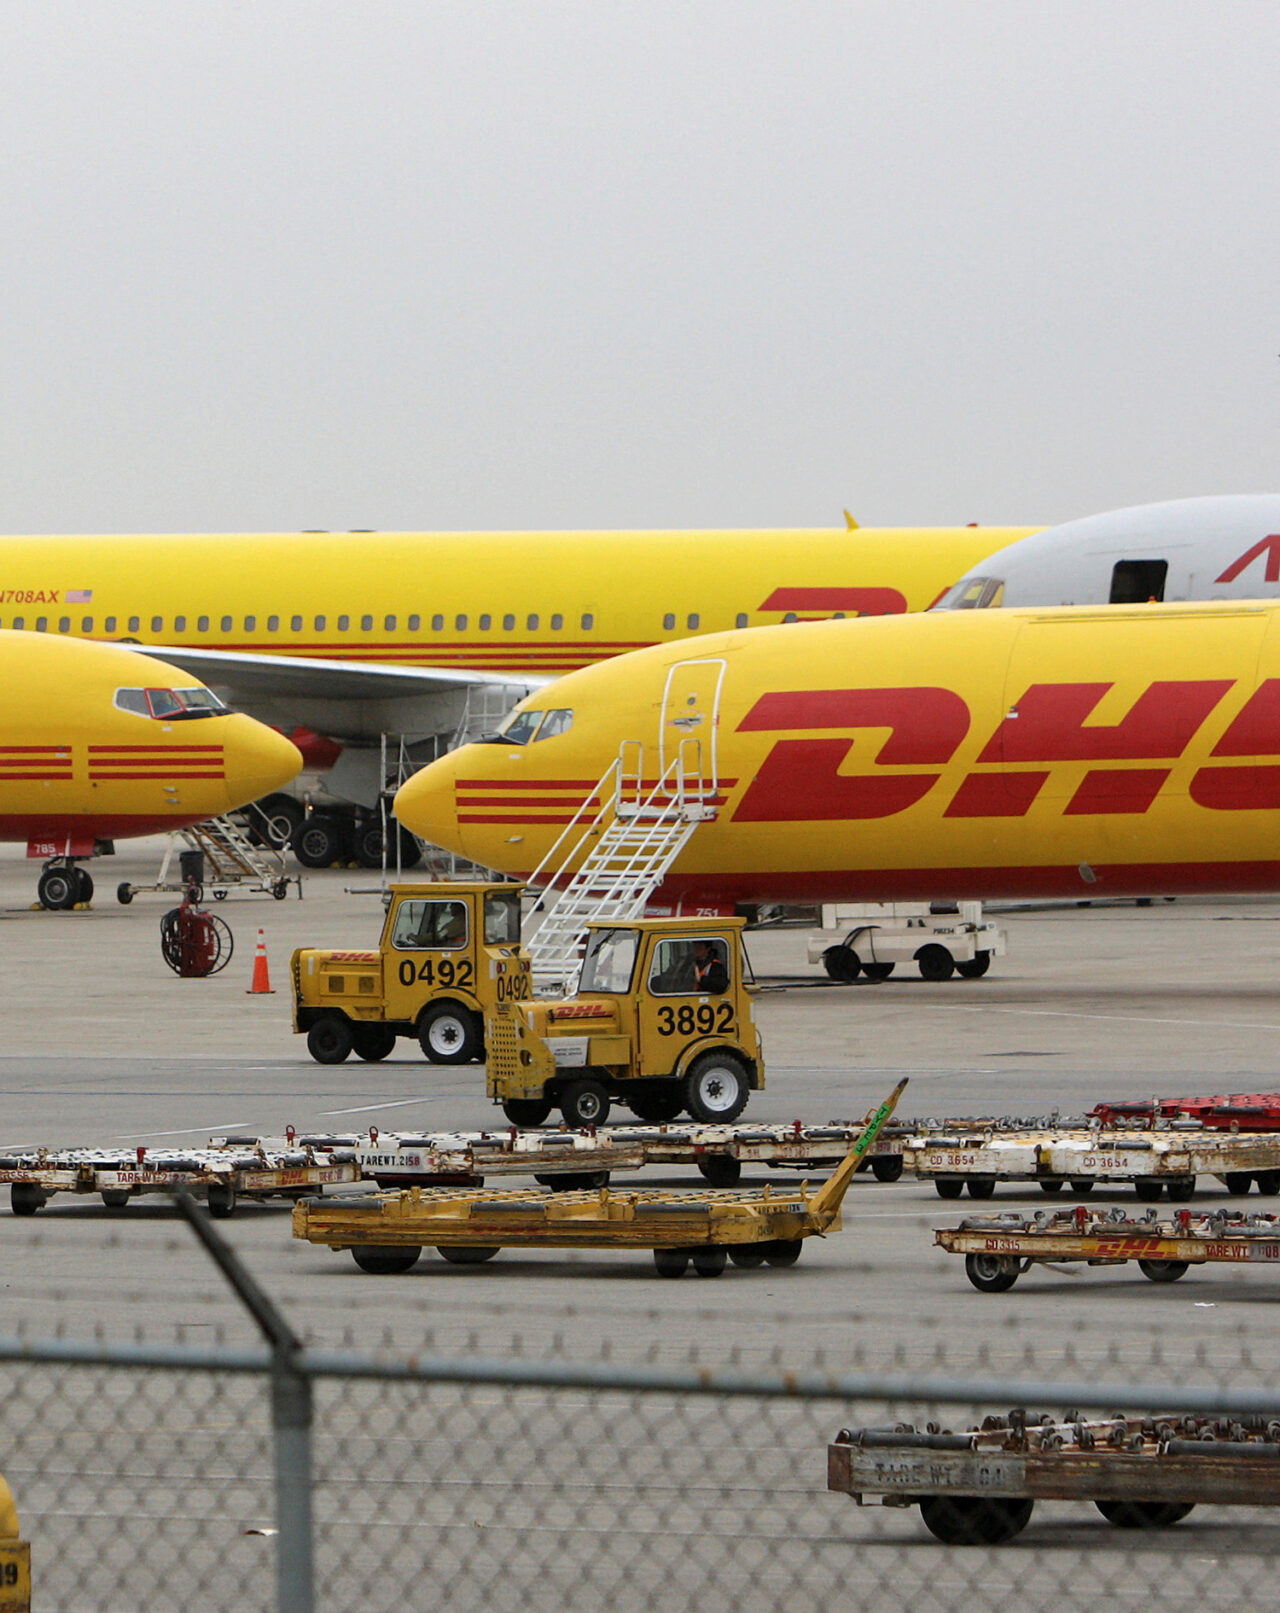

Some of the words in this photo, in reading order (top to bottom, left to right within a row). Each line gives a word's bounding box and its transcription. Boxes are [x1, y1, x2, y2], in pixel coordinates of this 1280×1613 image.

[34, 843, 56, 854] 785
[696, 907, 719, 918] 751
[329, 952, 375, 963] DHL
[399, 959, 474, 987] 0492
[497, 974, 529, 1002] 0492
[556, 1004, 608, 1018] DHL
[657, 1003, 735, 1036] 3892
[864, 1106, 889, 1140] TYPE
[930, 1155, 943, 1165] CD
[947, 1155, 976, 1165] 3654
[1083, 1157, 1096, 1167] CD
[1100, 1158, 1129, 1168] 3654
[117, 1172, 139, 1183] TARE
[1096, 1239, 1166, 1258] DHL
[1205, 1244, 1230, 1258] TARE
